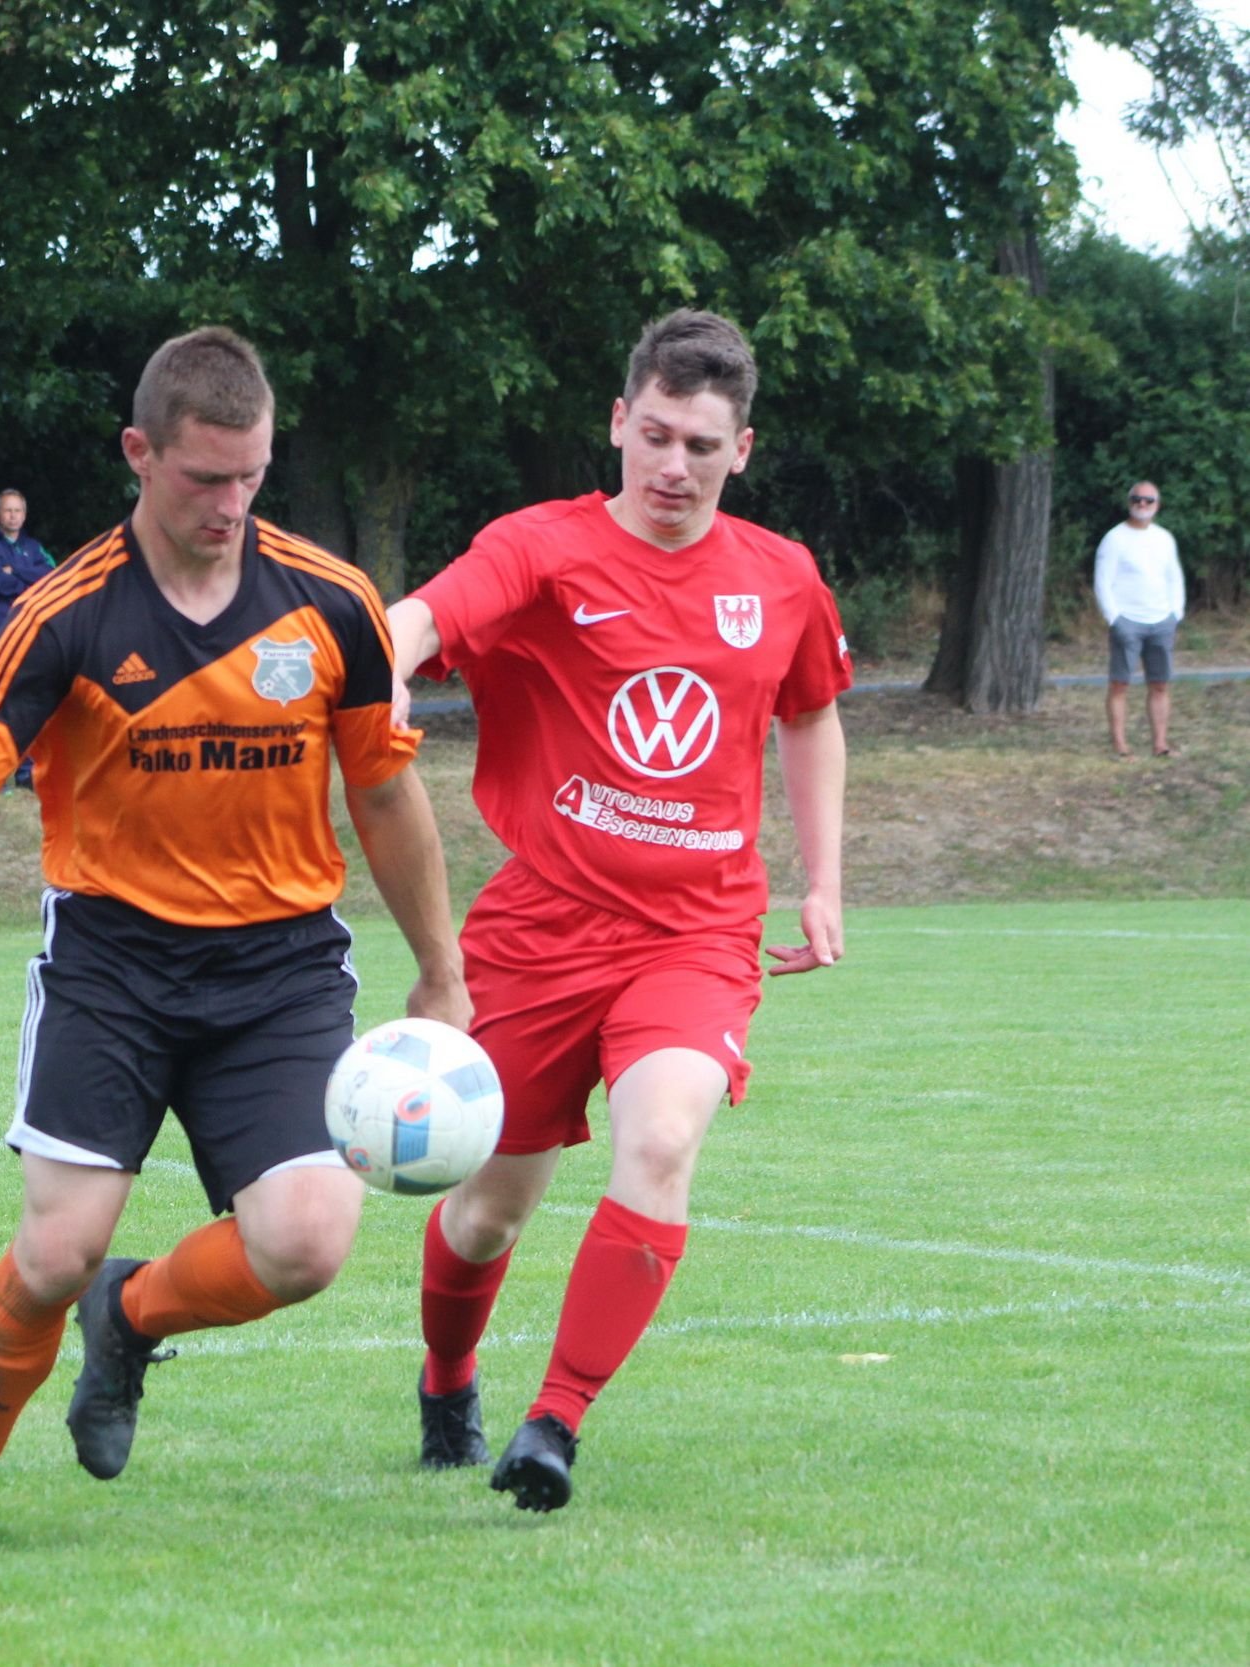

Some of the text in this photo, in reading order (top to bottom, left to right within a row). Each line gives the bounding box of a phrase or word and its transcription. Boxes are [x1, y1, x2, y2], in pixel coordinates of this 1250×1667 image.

[112, 669, 157, 685] adidas
[616, 671, 714, 770] VW
[130, 740, 306, 772] Falko Manz
[553, 774, 694, 822] AUTOHAUS
[593, 806, 744, 850] ESCHENGRUND
